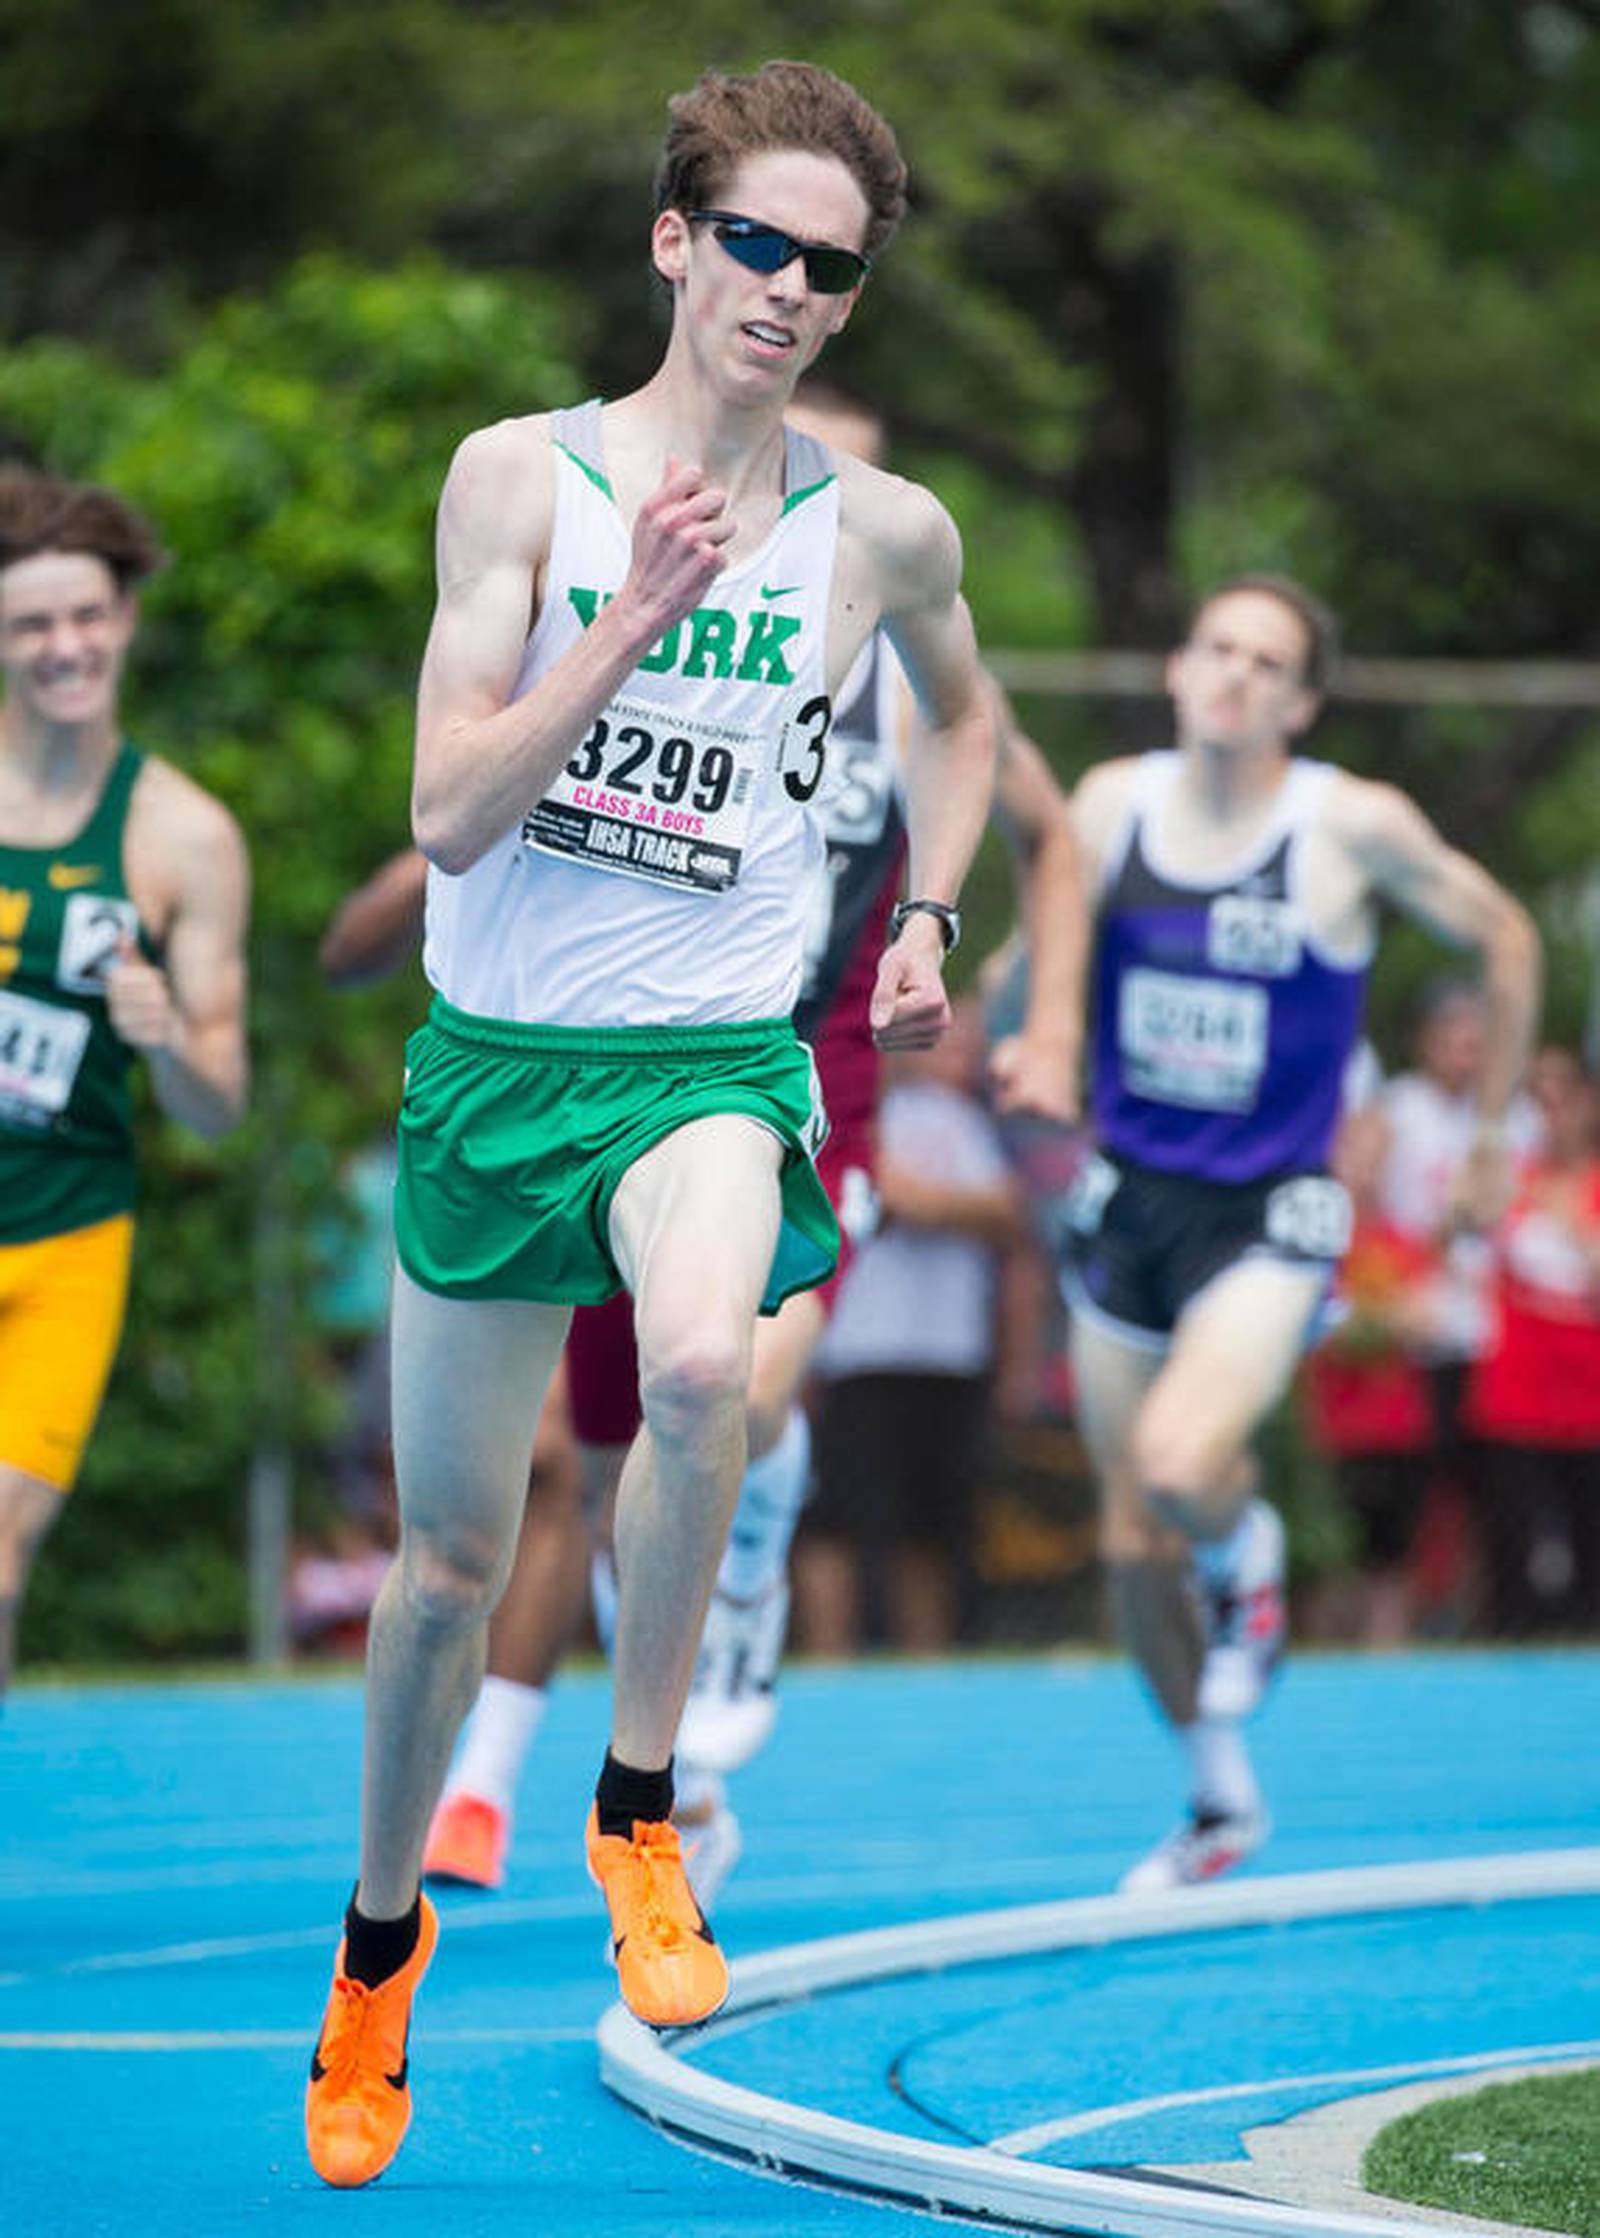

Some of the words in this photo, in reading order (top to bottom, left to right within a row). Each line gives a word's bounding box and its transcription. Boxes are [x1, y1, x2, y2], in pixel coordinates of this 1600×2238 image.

[566, 718, 734, 814] 3299
[783, 695, 831, 803] 3
[573, 785, 631, 817] CLASS
[634, 802, 657, 826] 3A
[660, 809, 706, 836] BOYS
[632, 825, 695, 873] TRACK
